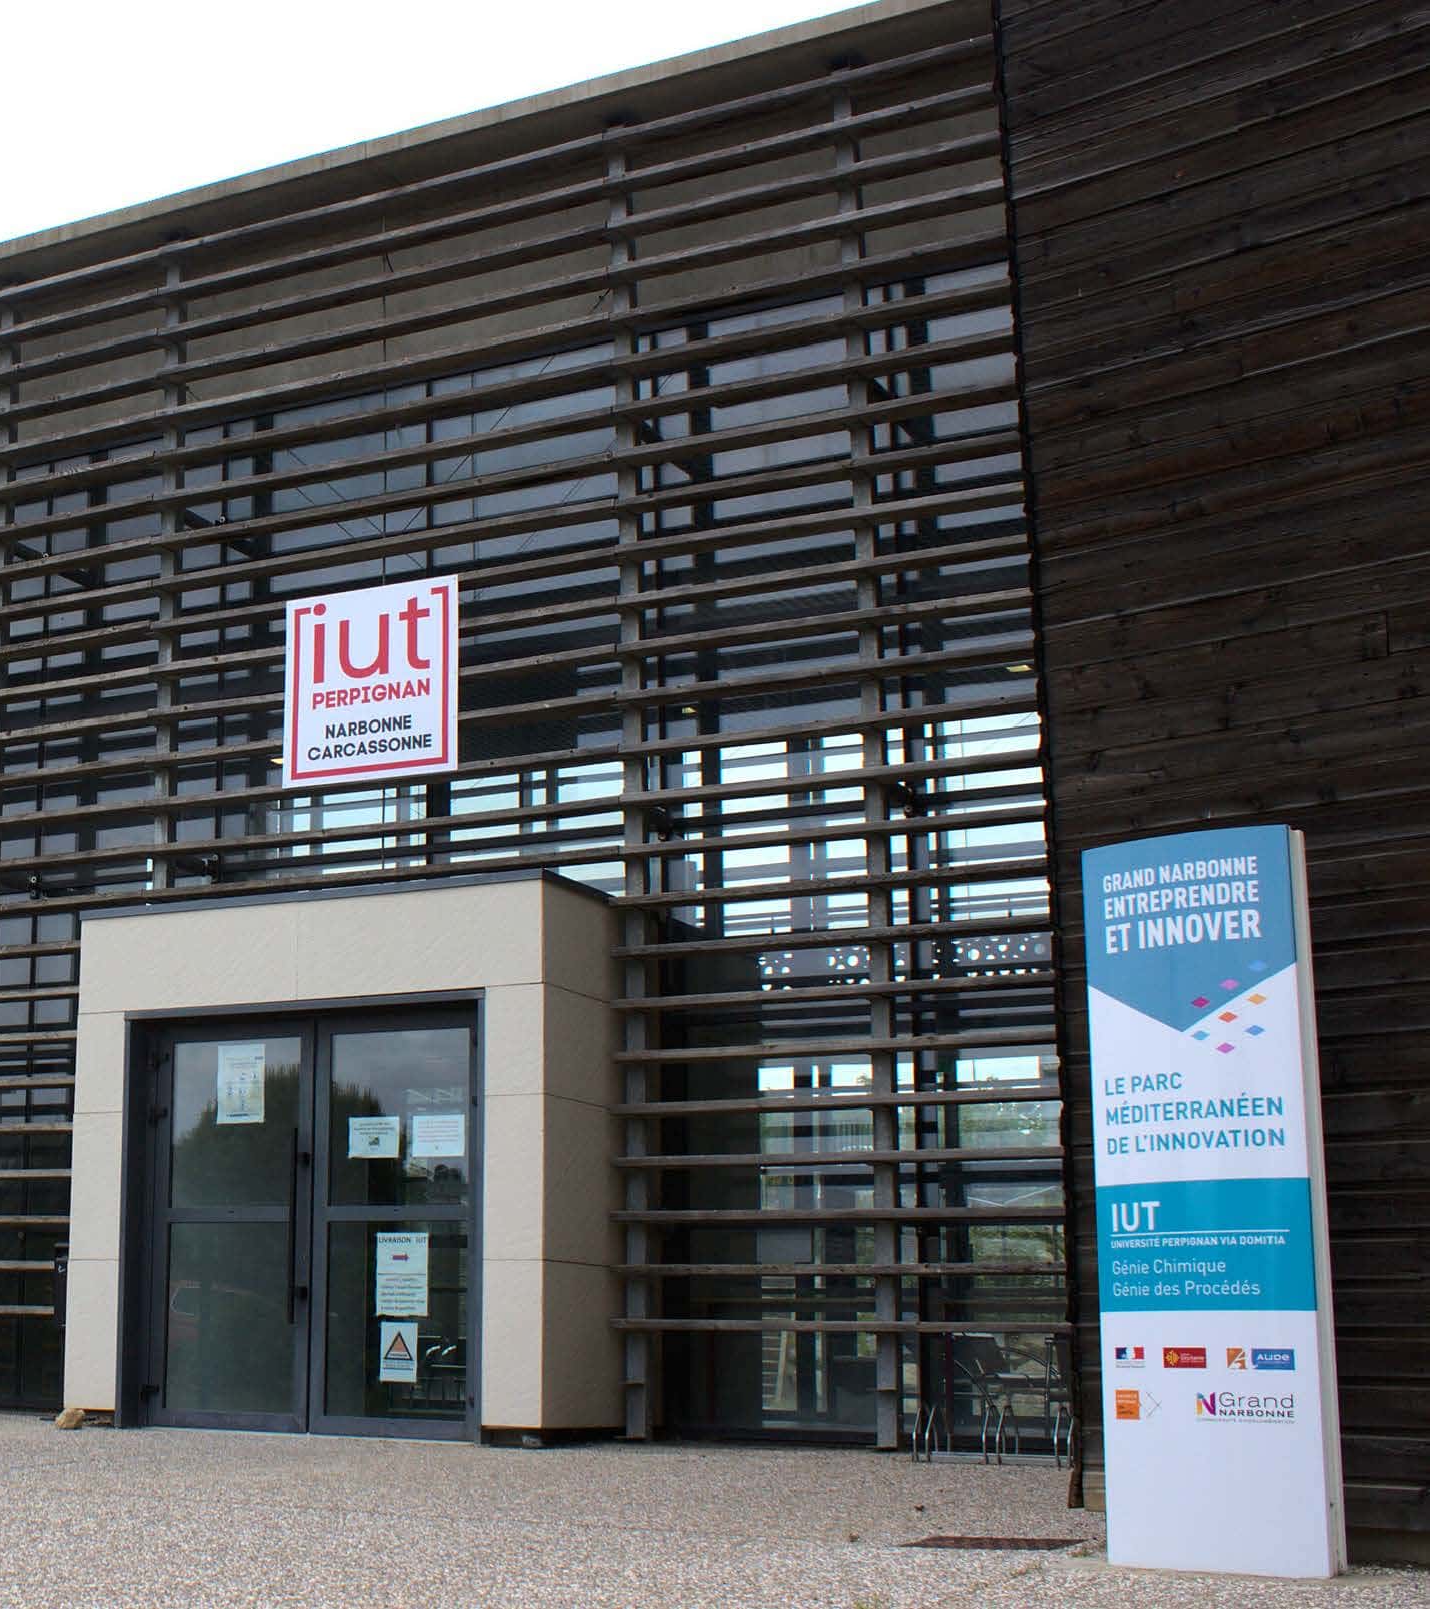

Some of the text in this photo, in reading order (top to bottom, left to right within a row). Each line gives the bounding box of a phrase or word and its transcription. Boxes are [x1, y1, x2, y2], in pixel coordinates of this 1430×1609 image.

[312, 678, 430, 710] PERPIGNAN
[325, 714, 412, 739] NARBONNE
[307, 734, 432, 761] CARCASSONNE
[1103, 856, 1258, 893] GRAND NARBONNE
[1104, 880, 1259, 920] ENTREPRENDRE
[1105, 909, 1262, 954] ET INNOVER
[1105, 1072, 1182, 1096] LE PARC
[1106, 1092, 1283, 1126] MÉDITERRANÉEN
[1107, 1128, 1285, 1156] DE L'INNOVATION
[1111, 1201, 1160, 1232] IUT
[1111, 1235, 1286, 1249] UNIVERSITÉ PERPIGNAN VIA DOMITIA
[1112, 1258, 1226, 1277] Génie Chimique
[1113, 1280, 1261, 1297] Génie des Procédés
[1220, 1391, 1294, 1409] Grand
[1220, 1409, 1295, 1418] NARBONNE
